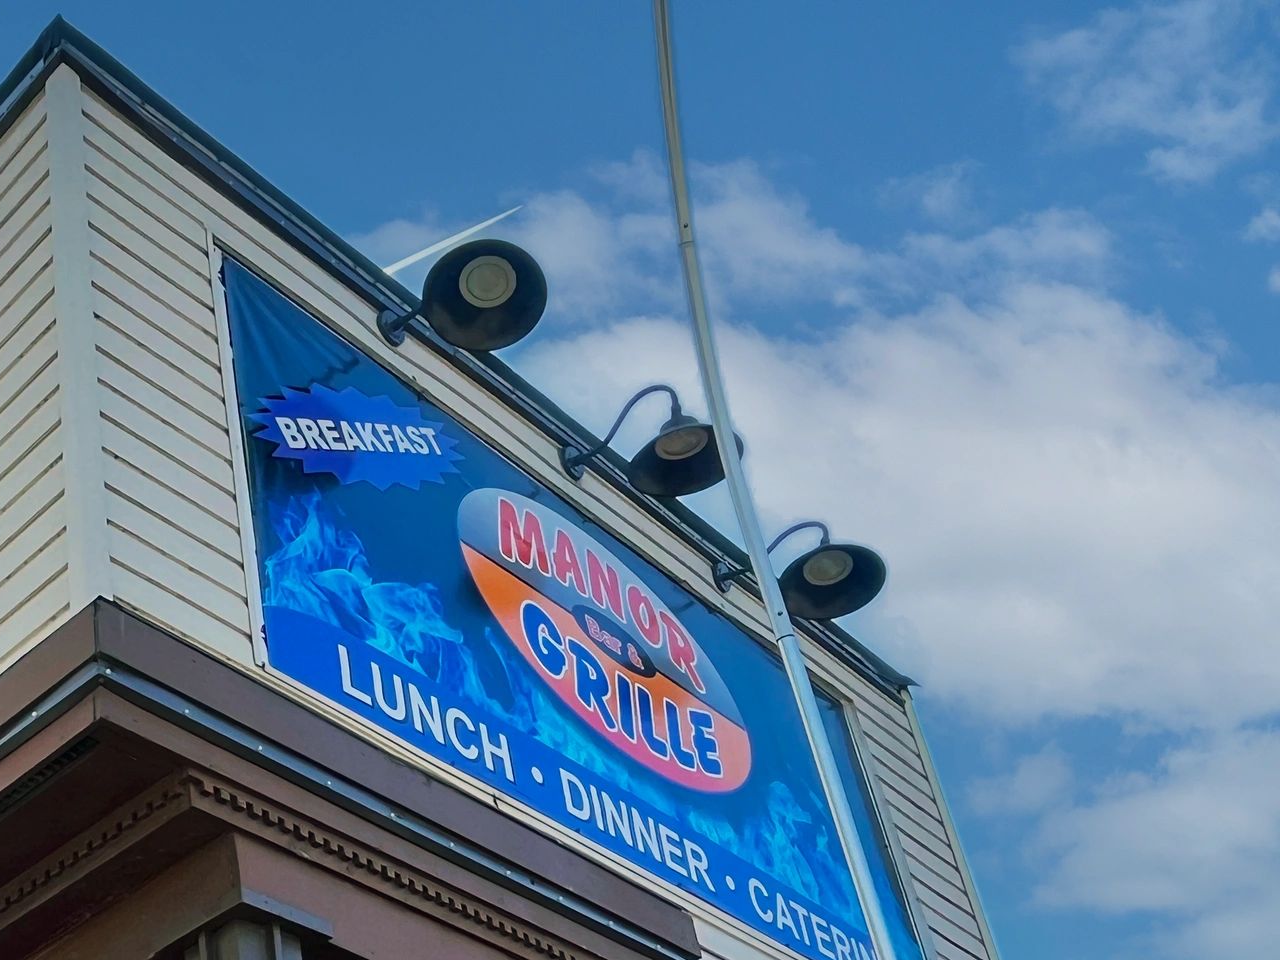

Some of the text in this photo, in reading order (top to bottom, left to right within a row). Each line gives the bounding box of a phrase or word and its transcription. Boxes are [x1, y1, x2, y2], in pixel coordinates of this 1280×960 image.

[274, 414, 446, 458] BREAKFAST
[498, 496, 707, 694] MANOR
[584, 613, 645, 671] Bar &
[336, 643, 515, 784] LUNCH
[559, 767, 717, 892] DINNER
[519, 598, 724, 780] GRILLE
